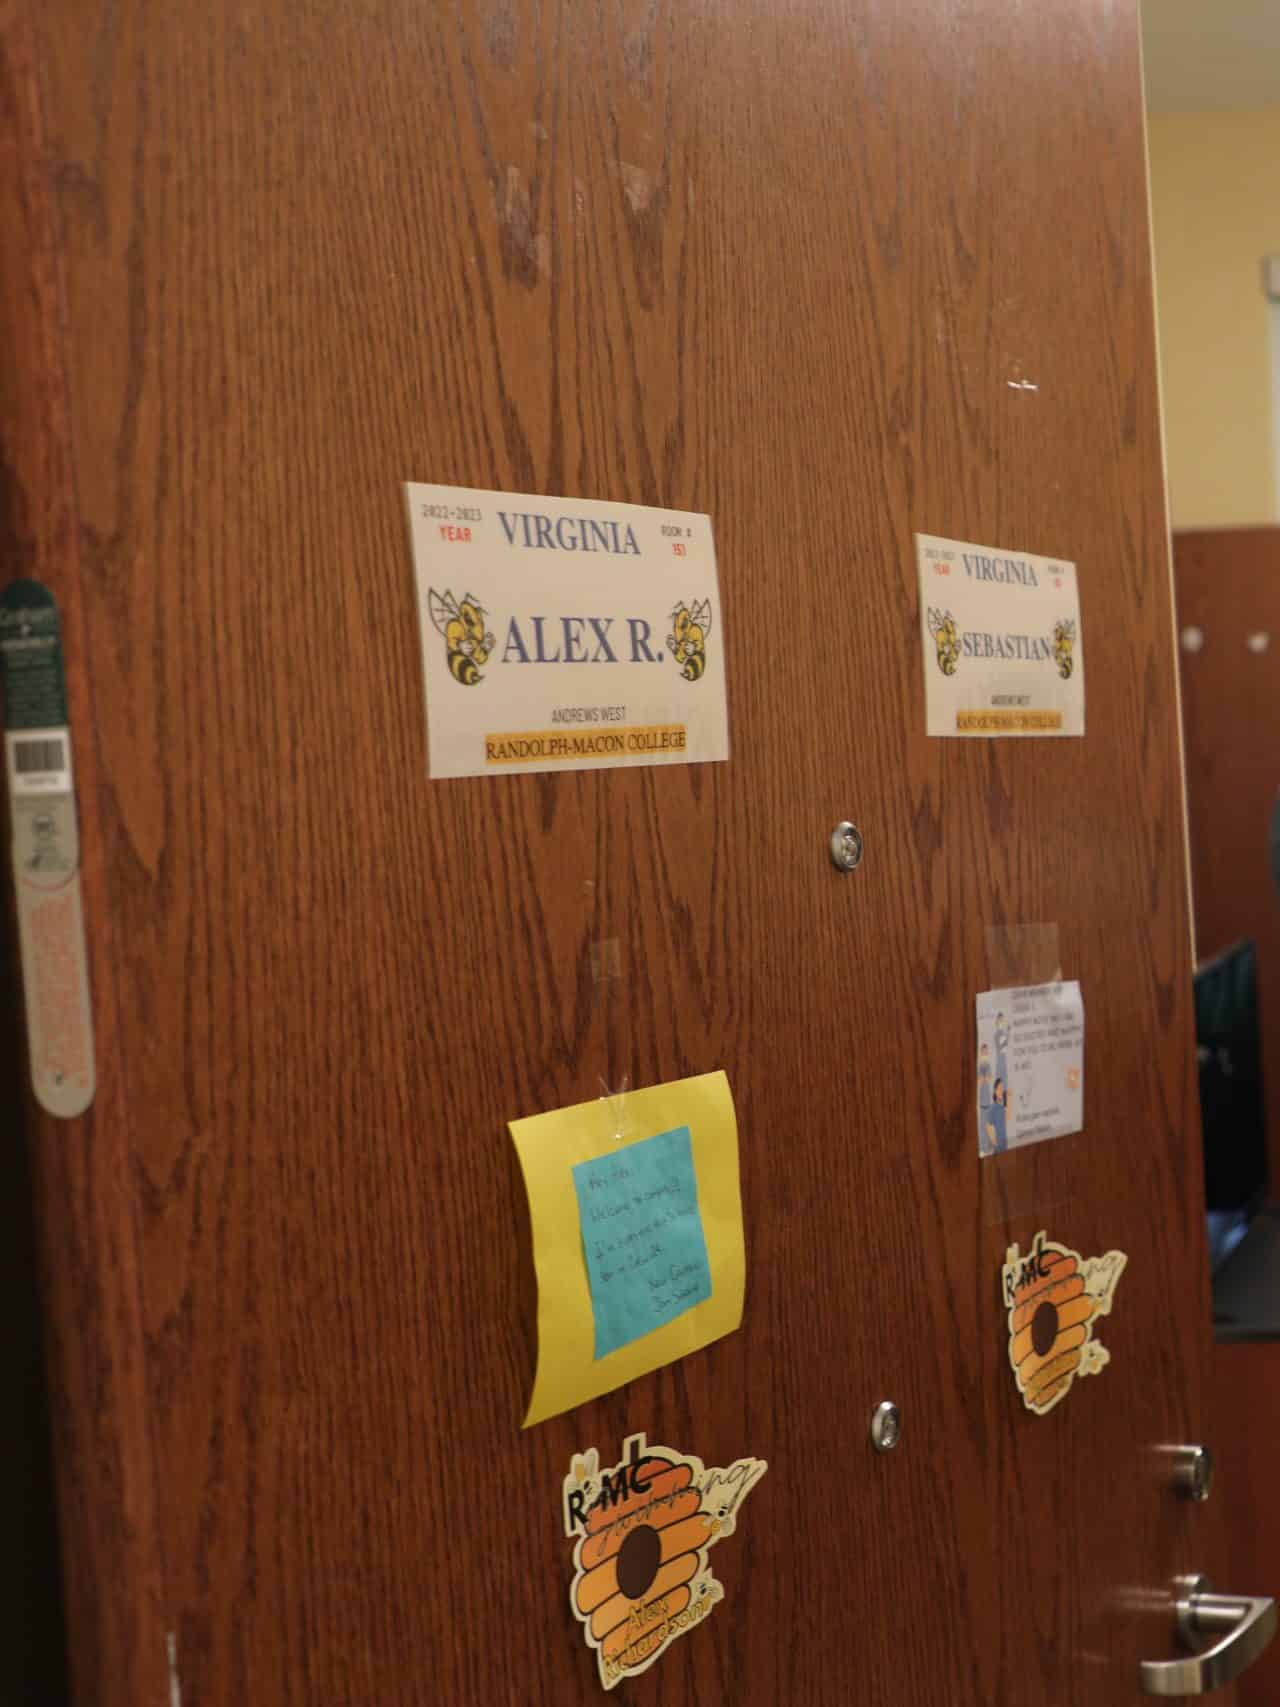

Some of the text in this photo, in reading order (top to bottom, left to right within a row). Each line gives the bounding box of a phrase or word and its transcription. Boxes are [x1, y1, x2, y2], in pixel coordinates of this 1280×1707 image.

[438, 525, 472, 543] YEAR
[497, 511, 641, 555] VIRGINIA
[961, 553, 1038, 587] VIRGINIA
[501, 614, 664, 663] ALEX R.
[962, 631, 1050, 661] SEBASTIAN
[551, 705, 627, 723] ANDREWS WEST
[486, 731, 686, 760] RANDOLPH-MACON COLLEGE
